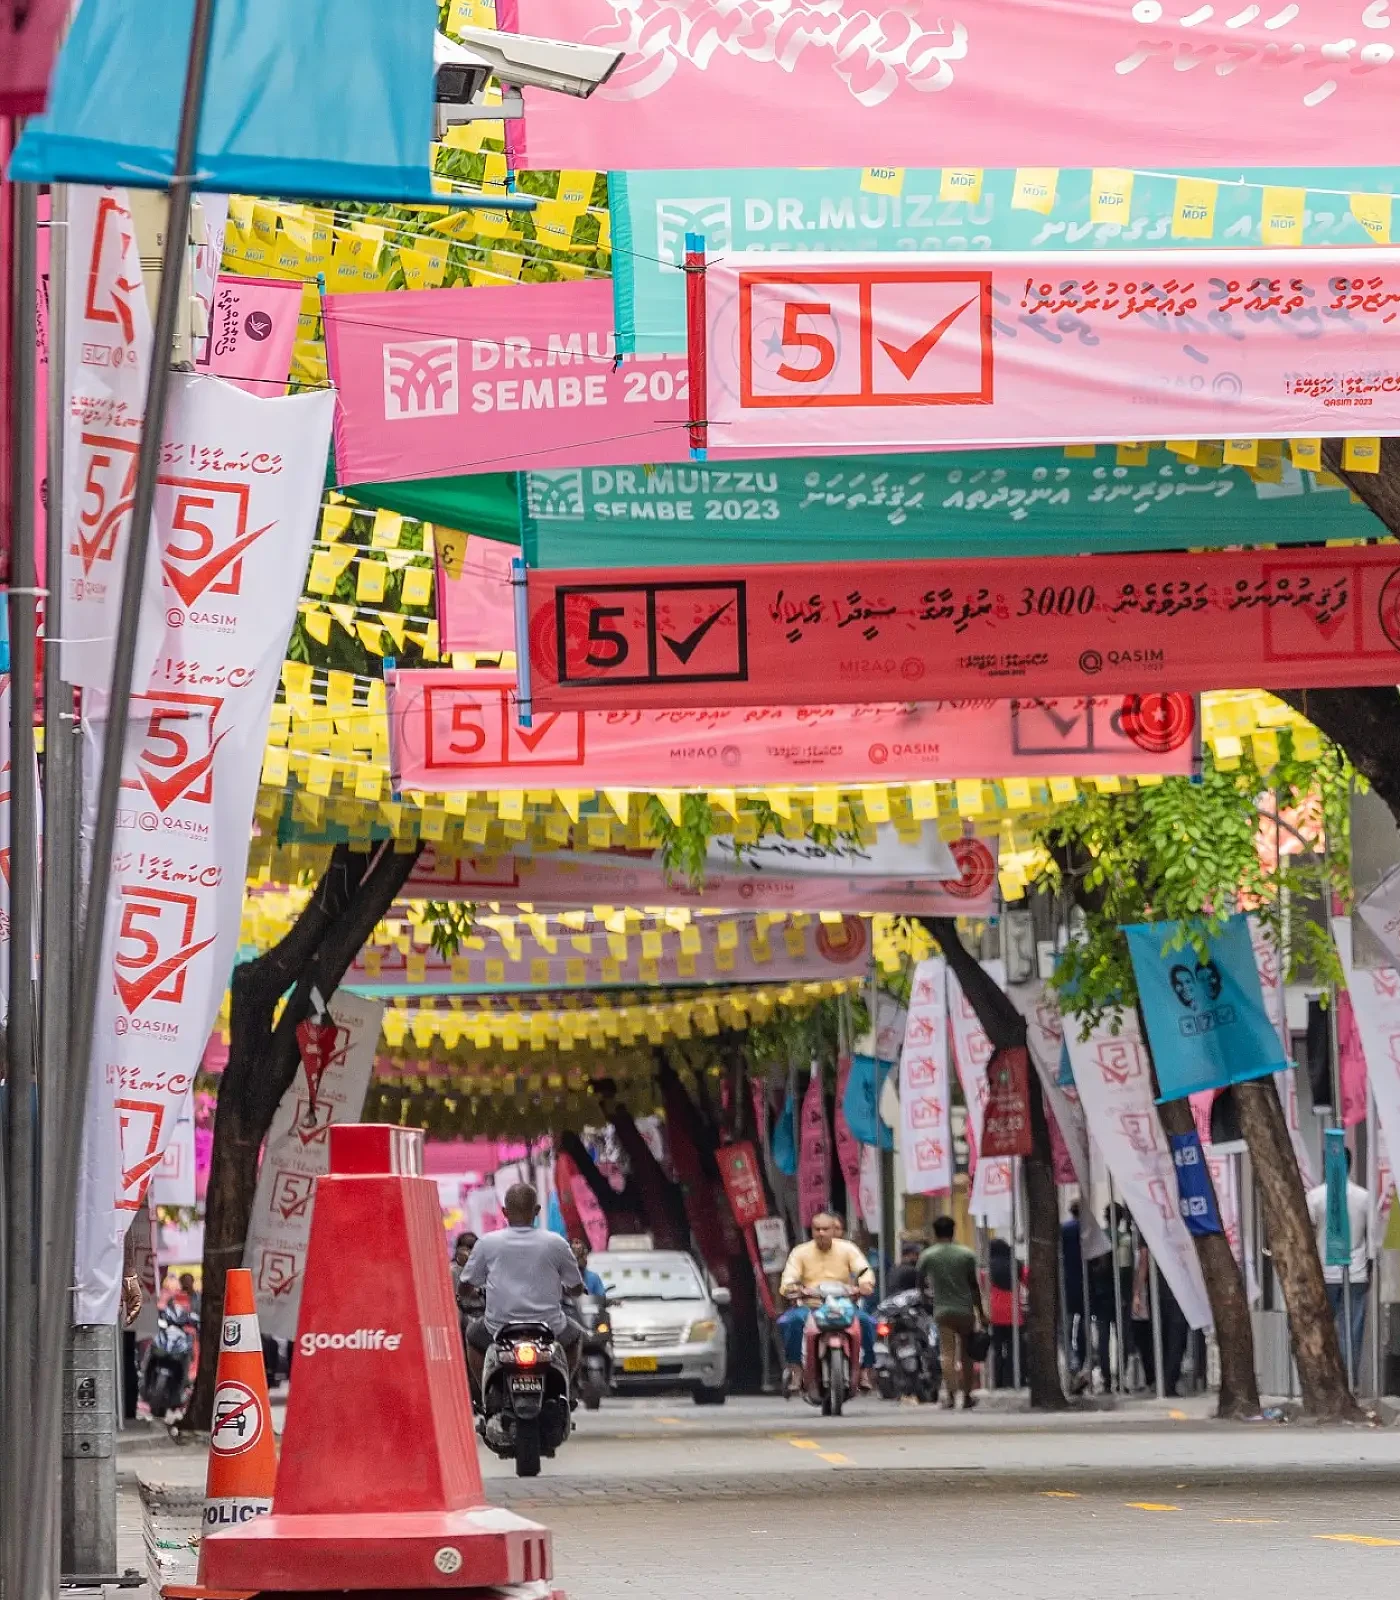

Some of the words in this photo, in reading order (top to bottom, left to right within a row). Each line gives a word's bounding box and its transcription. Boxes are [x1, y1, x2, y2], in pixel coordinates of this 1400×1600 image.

[870, 168, 896, 180] MDP
[950, 176, 976, 187] MDP
[563, 193, 585, 202] MDP
[1022, 185, 1048, 197] MDP
[1098, 195, 1124, 207] MDP
[744, 194, 993, 231] DR.MUIZZU
[1182, 208, 1207, 221] MDP
[1270, 218, 1296, 230] MDP
[244, 250, 265, 260] MDP
[279, 258, 299, 267] MDP
[305, 255, 325, 263] MDP
[337, 266, 359, 276] MDP
[777, 303, 836, 381] 5
[471, 375, 607, 413] SEMBE
[623, 371, 688, 404] 202
[81, 455, 110, 526] 5
[592, 470, 779, 497] DR.MUIZZU
[593, 501, 695, 521] SEMBE
[705, 499, 780, 521] 2023
[166, 495, 214, 561] 5
[1016, 585, 1095, 617] 3000
[189, 611, 238, 627] QASIM
[585, 608, 629, 668] 5
[1106, 648, 1164, 663] QASIM
[140, 708, 188, 768] 5
[450, 704, 486, 754] 5
[162, 815, 210, 835] QASIM
[115, 902, 162, 969] 5
[130, 1019, 179, 1036] QASIM
[300, 1329, 401, 1356] goodlife
